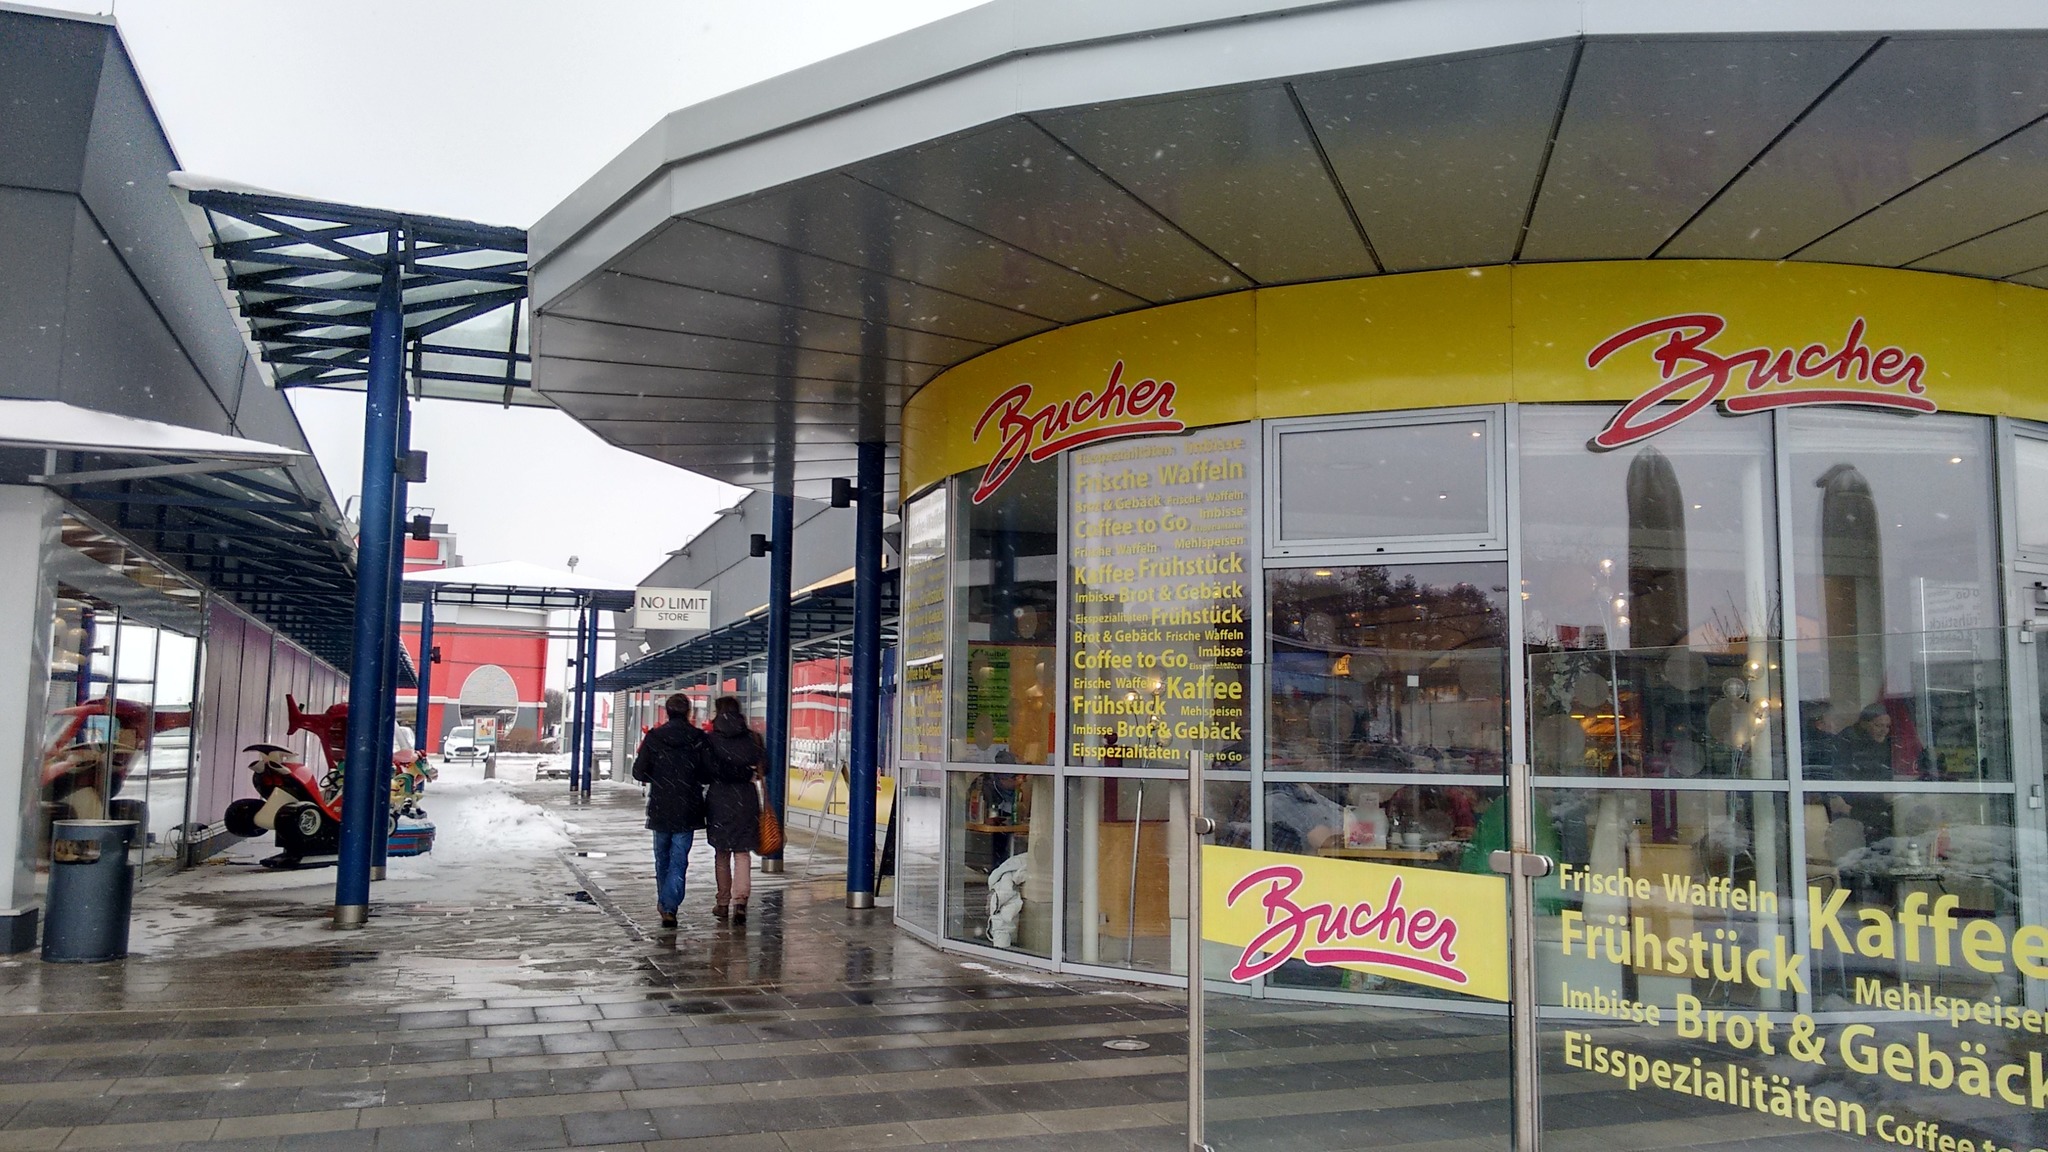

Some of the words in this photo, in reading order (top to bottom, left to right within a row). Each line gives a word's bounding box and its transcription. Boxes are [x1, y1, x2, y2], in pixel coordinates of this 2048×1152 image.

[1586, 313, 1930, 447] Bucher
[972, 359, 1178, 505] Bucher
[1076, 468, 1148, 494] Frische
[1157, 457, 1244, 486] Waffeln
[1205, 490, 1244, 502] Waffeln
[1200, 506, 1244, 519] Imbisse
[1074, 518, 1132, 539] Coffee
[1137, 519, 1156, 533] to
[1161, 513, 1188, 532] Go
[1175, 535, 1244, 549] Mehlspeisen
[1074, 564, 1135, 585] Kaffee
[1138, 551, 1243, 578] Frühstück
[640, 596, 665, 609] NO
[668, 597, 708, 610] LIMIT
[1075, 592, 1115, 604] Imbisse
[1119, 586, 1155, 603] Brot
[1159, 584, 1172, 601] &
[1175, 580, 1243, 601] Gebäck
[658, 612, 689, 622] STORE
[1075, 613, 1148, 625] Eisspezialitäten
[1151, 603, 1243, 626] Frühstück
[1074, 631, 1101, 644] Brot
[1103, 630, 1112, 643] &
[1115, 628, 1162, 642] Gebäck
[1166, 631, 1201, 642] Frische
[1204, 628, 1244, 641] Waffeln
[1074, 649, 1133, 670] Coffee
[1137, 651, 1156, 668] to
[1160, 649, 1188, 668] Go
[1198, 646, 1244, 658] Imbisse
[1167, 675, 1243, 700] Kaffee
[1073, 695, 1167, 716] Frühstück
[1073, 724, 1113, 736] Imbisse
[1117, 721, 1153, 738] Brot
[1157, 721, 1172, 738] &
[1174, 722, 1242, 740] Gebäck
[1072, 743, 1181, 761] Eisspezialitäten
[1216, 753, 1227, 761] to
[1228, 751, 1243, 762] Go
[1559, 863, 1651, 900] Frische
[1662, 872, 1778, 914] Waffeln
[1226, 865, 1461, 983] Bucher
[1808, 886, 2048, 980] Kaffee
[1561, 909, 1808, 994] Frühstück
[1562, 981, 1660, 1026] Imbisse
[1676, 993, 1775, 1056] Brot
[1788, 1013, 1826, 1065] &
[1565, 1030, 1867, 1136] Eisspezialitäten
[1876, 1114, 1975, 1152] Coffee
